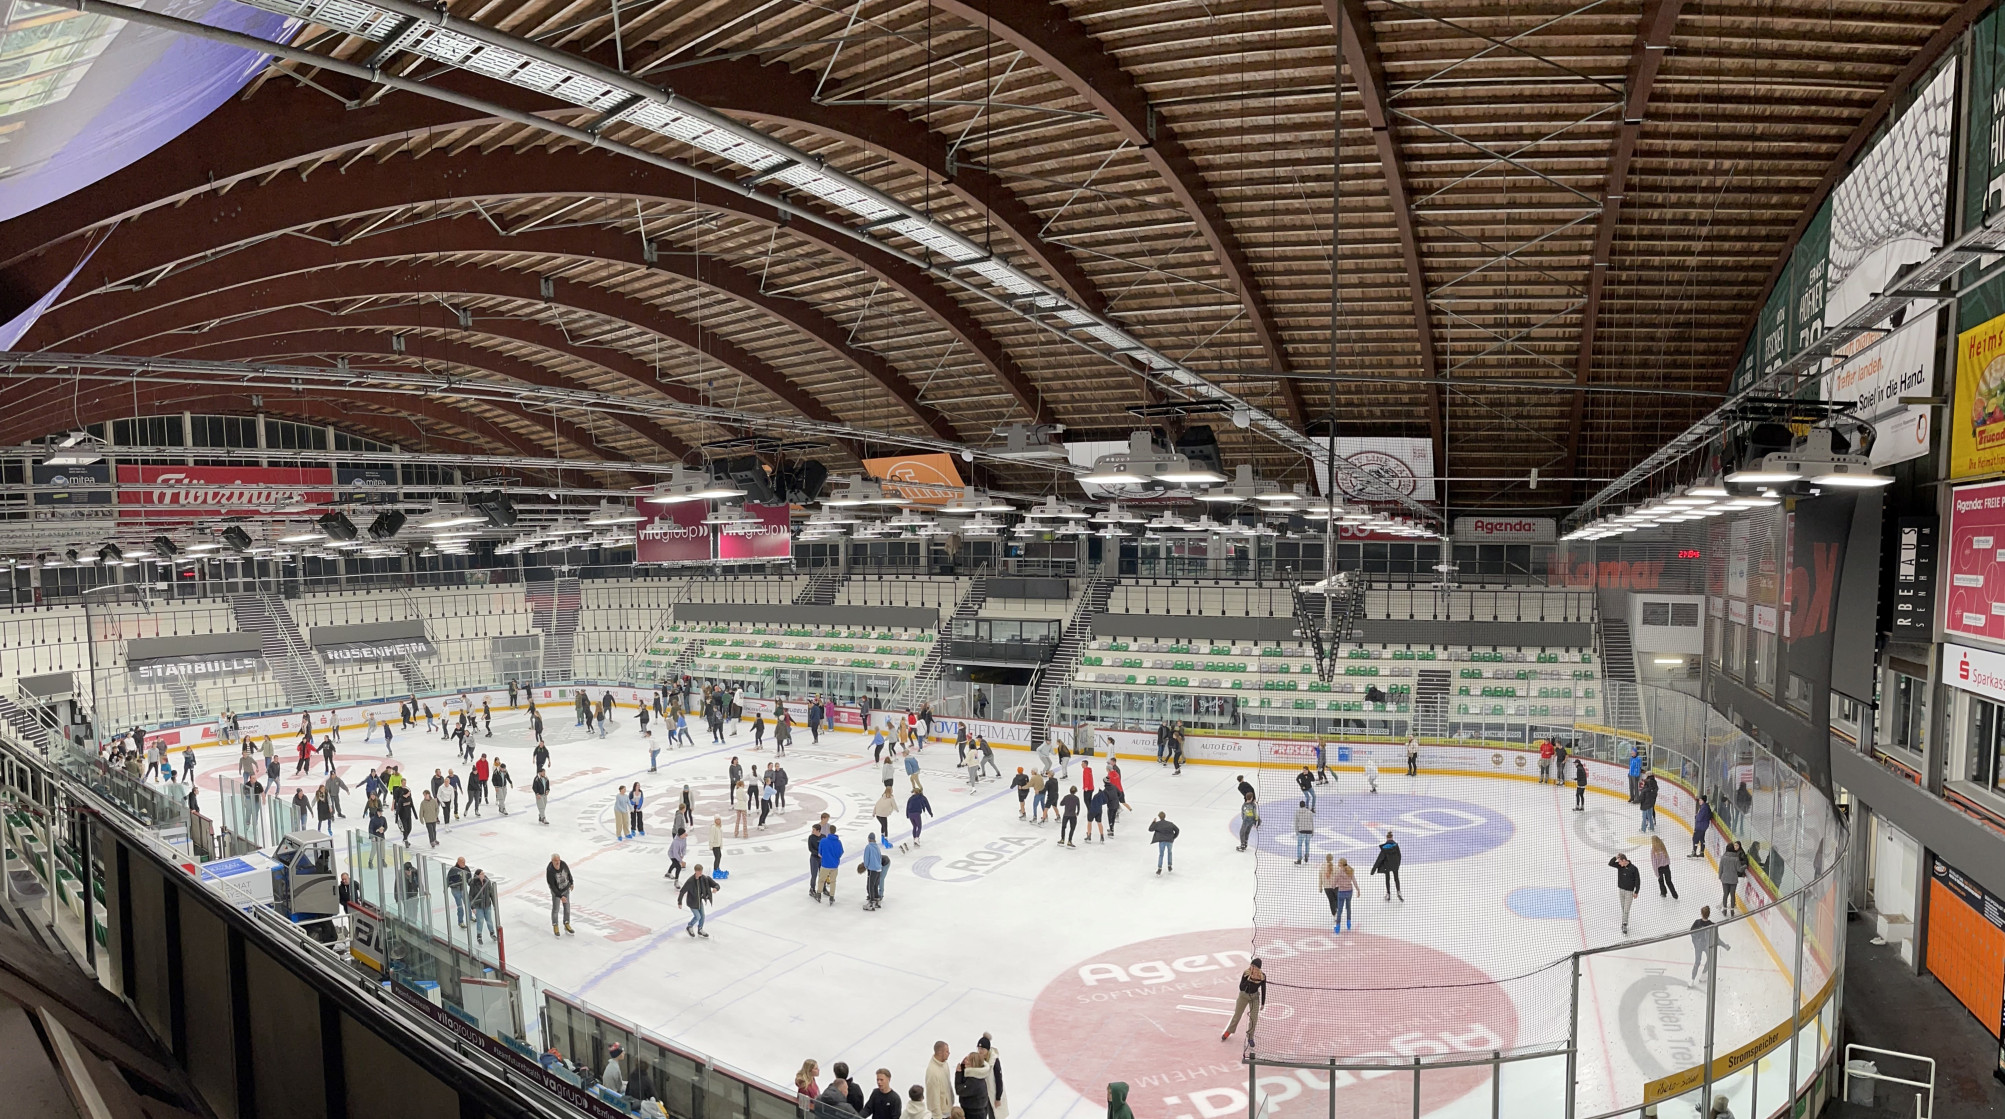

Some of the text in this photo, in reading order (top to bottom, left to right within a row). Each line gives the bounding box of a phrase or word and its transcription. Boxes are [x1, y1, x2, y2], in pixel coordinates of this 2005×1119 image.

[1900, 364, 1925, 394] Hand.
[1474, 519, 1536, 535] Agenda:
[327, 642, 427, 661] ROSENHEIM
[139, 657, 256, 679] STARBULLS
[437, 1012, 478, 1045] vitagroup
[1728, 1032, 1780, 1068] Stromspeicher
